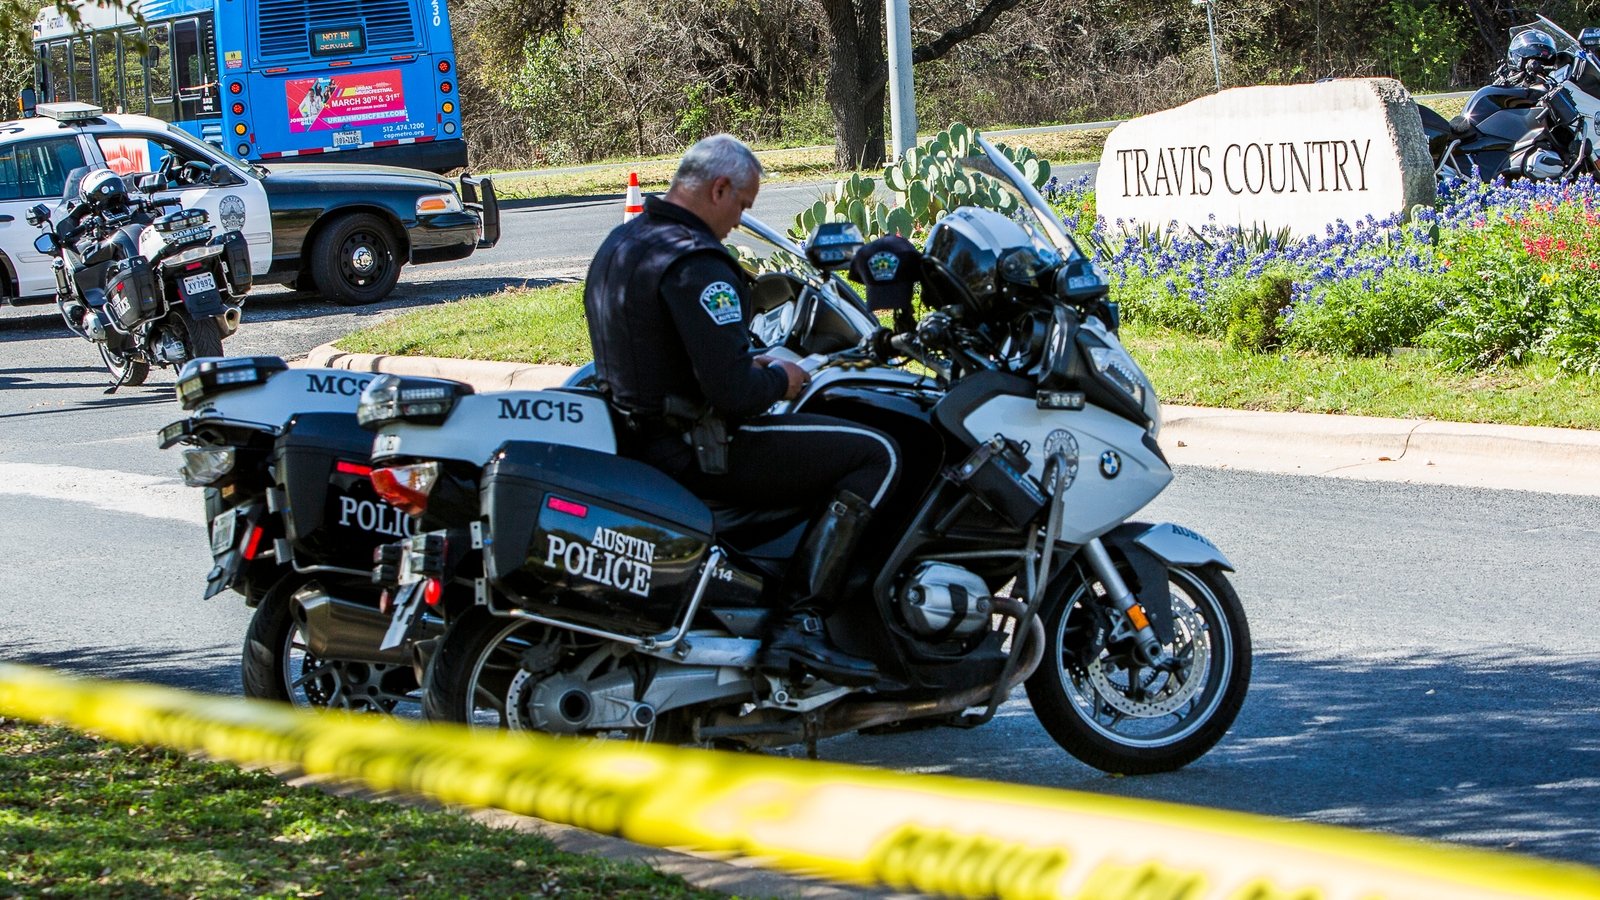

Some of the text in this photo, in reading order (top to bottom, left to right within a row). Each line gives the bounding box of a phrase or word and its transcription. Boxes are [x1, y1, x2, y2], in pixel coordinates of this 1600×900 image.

[322, 31, 349, 41] NOT IN
[320, 42, 354, 50] SERVICE
[331, 97, 361, 108] MARCH
[362, 95, 378, 104] 30TH
[385, 93, 401, 102] 31ST
[327, 110, 406, 124] URBANMUSICFEST.COM
[382, 122, 425, 133] 512.474.1200
[383, 130, 425, 139] capmetro.org
[1117, 139, 1371, 197] TRAVIS COUNTRY
[172, 226, 204, 238] POLICE
[703, 283, 737, 302] POLICE
[497, 398, 584, 423] MC15
[338, 495, 413, 539] POLIC
[591, 526, 656, 564] AUSTIN
[543, 533, 653, 598] POLICE
